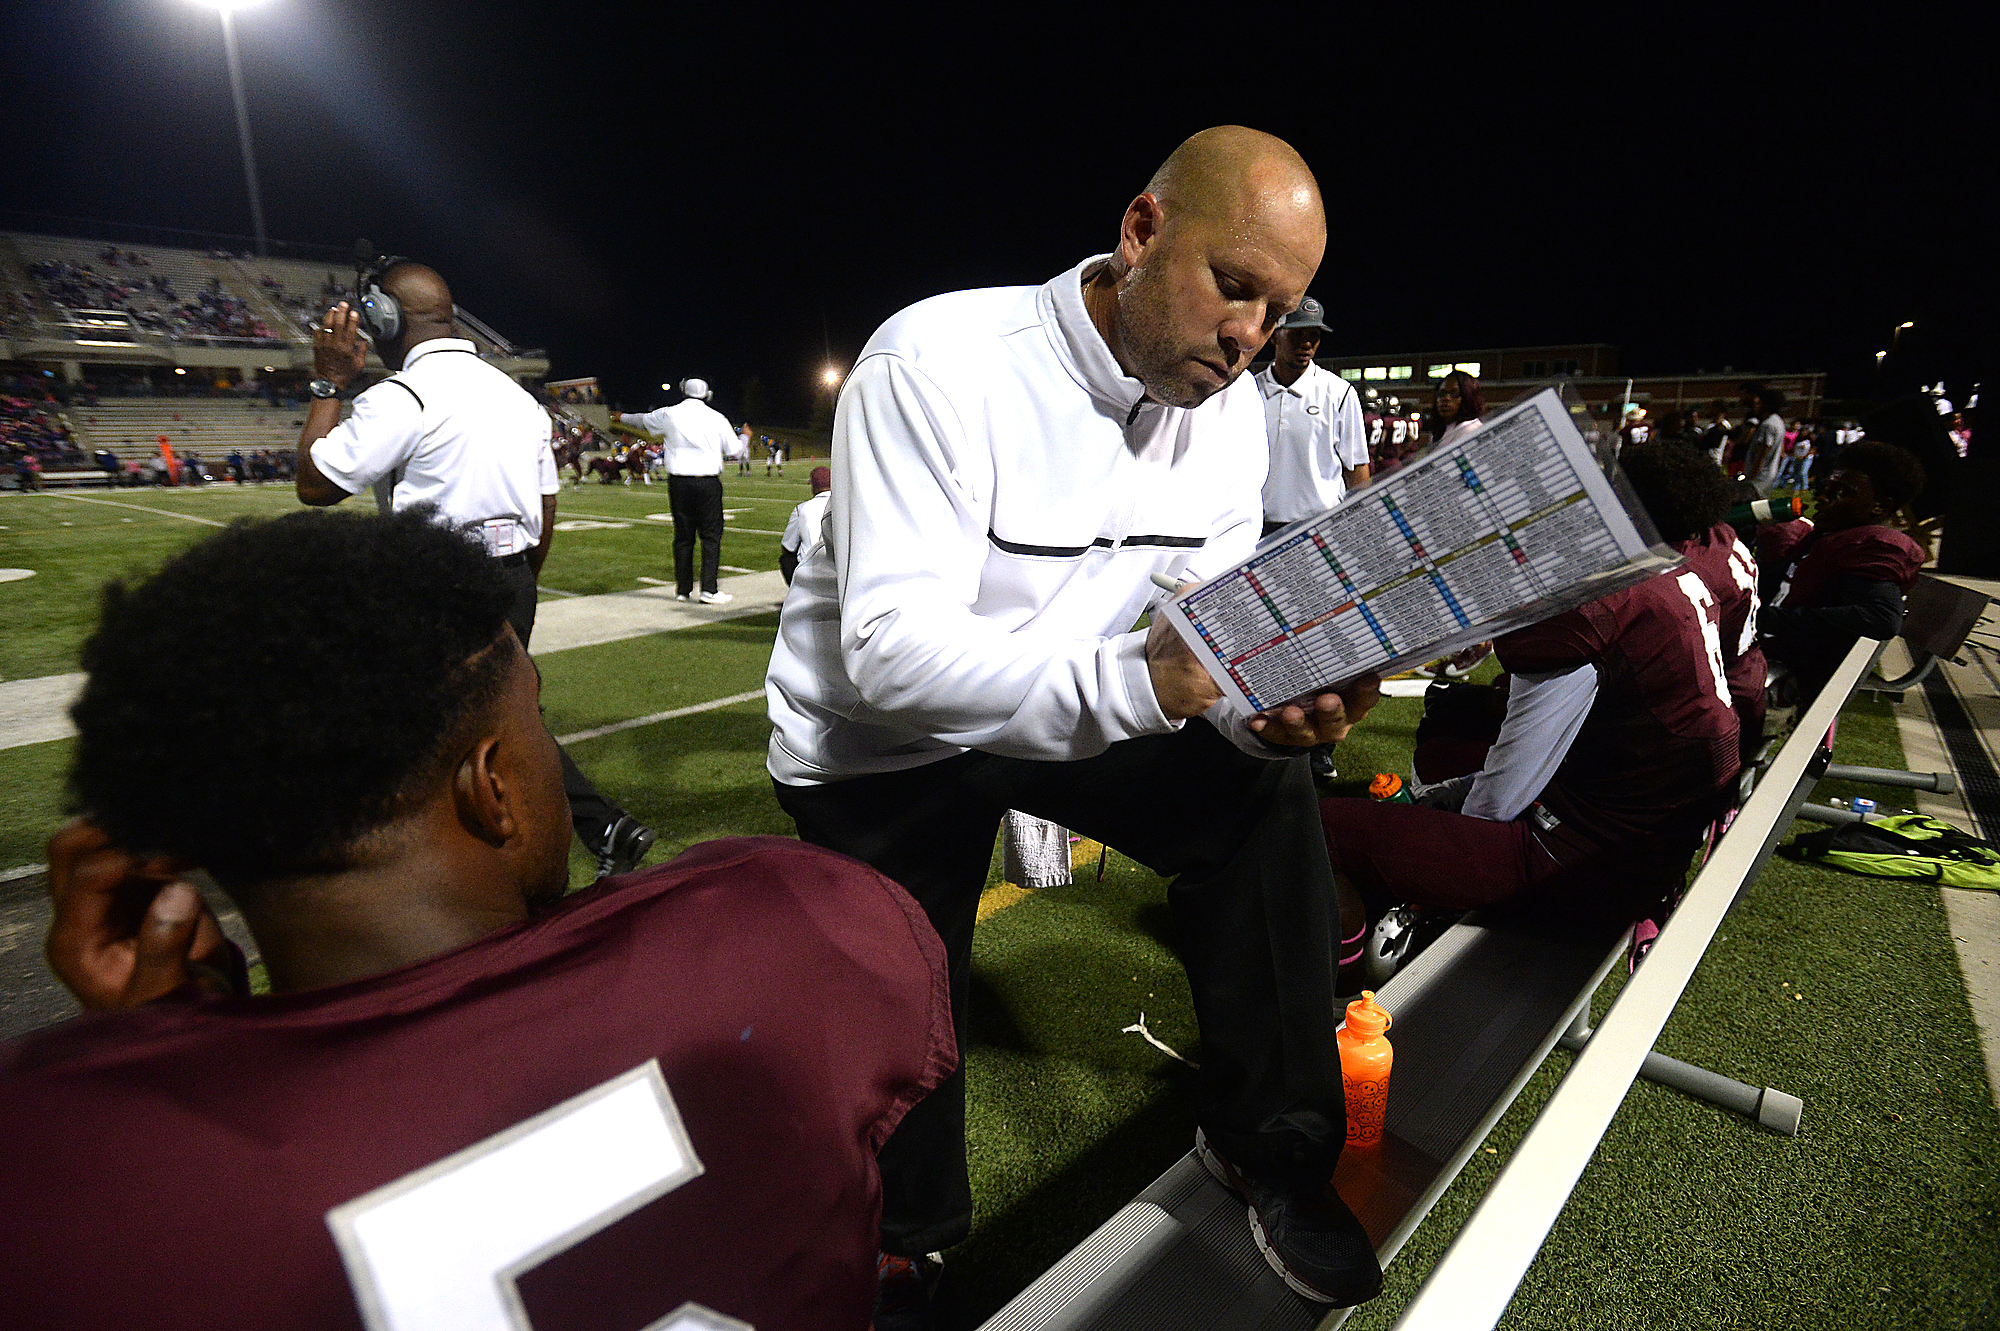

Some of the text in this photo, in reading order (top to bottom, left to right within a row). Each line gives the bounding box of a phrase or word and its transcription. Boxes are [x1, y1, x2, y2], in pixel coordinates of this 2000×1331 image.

[1303, 300, 1319, 312] C
[1306, 405, 1319, 415] C
[1282, 535, 1305, 550] PLAYS
[1190, 573, 1239, 602] OPENING SCRIPT
[1314, 611, 1336, 624] TEXAS
[1676, 571, 1733, 708] 6
[1244, 642, 1273, 658] RED ZONE
